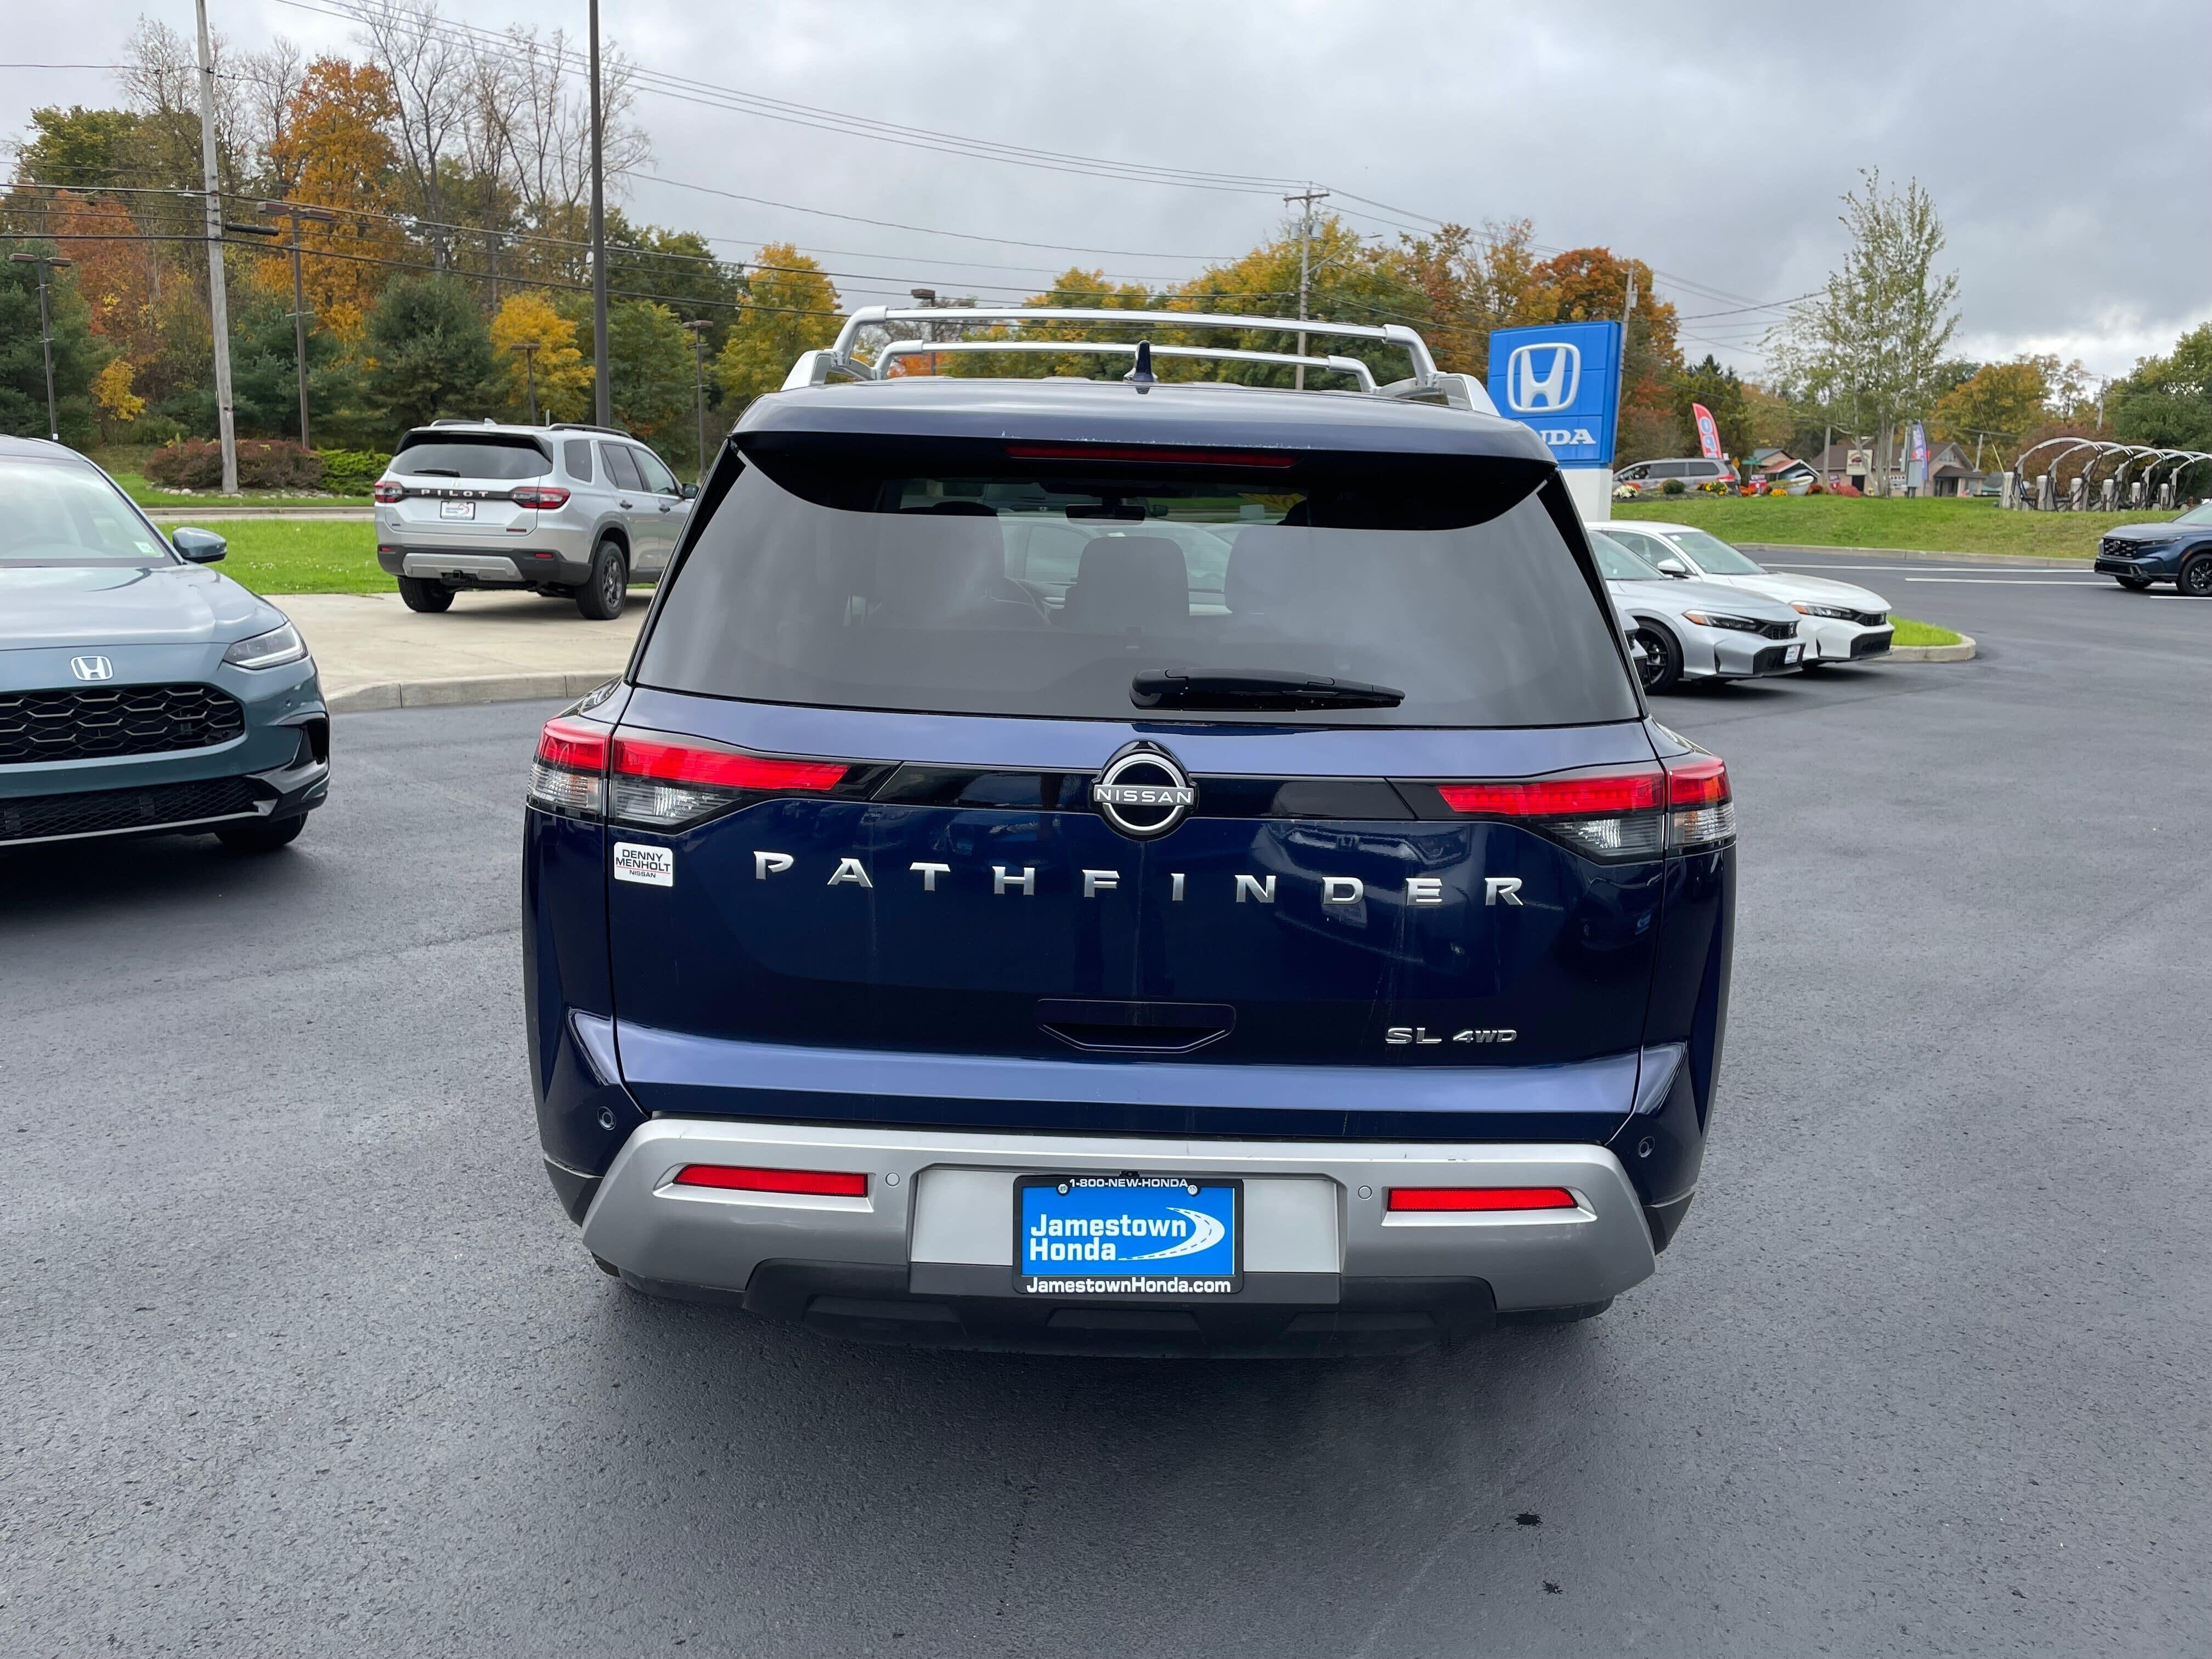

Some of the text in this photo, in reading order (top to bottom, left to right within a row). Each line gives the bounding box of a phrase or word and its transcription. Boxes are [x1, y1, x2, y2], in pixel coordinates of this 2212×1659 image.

[421, 489, 488, 498] PILOT
[1097, 788, 1192, 804] NISSAN
[622, 849, 663, 862] DENNY
[616, 857, 671, 872] MENHOLT
[629, 870, 656, 878] NISSAN
[753, 850, 1523, 906] PATHFINDER
[1385, 1027, 1517, 1044] SL 4WD
[1069, 1178, 1188, 1188] 1-800-NEW-HONDA
[1030, 1214, 1187, 1237] Jamestown
[1029, 1237, 1116, 1261] Honda
[1026, 1277, 1232, 1293] JamestownHonda.com
